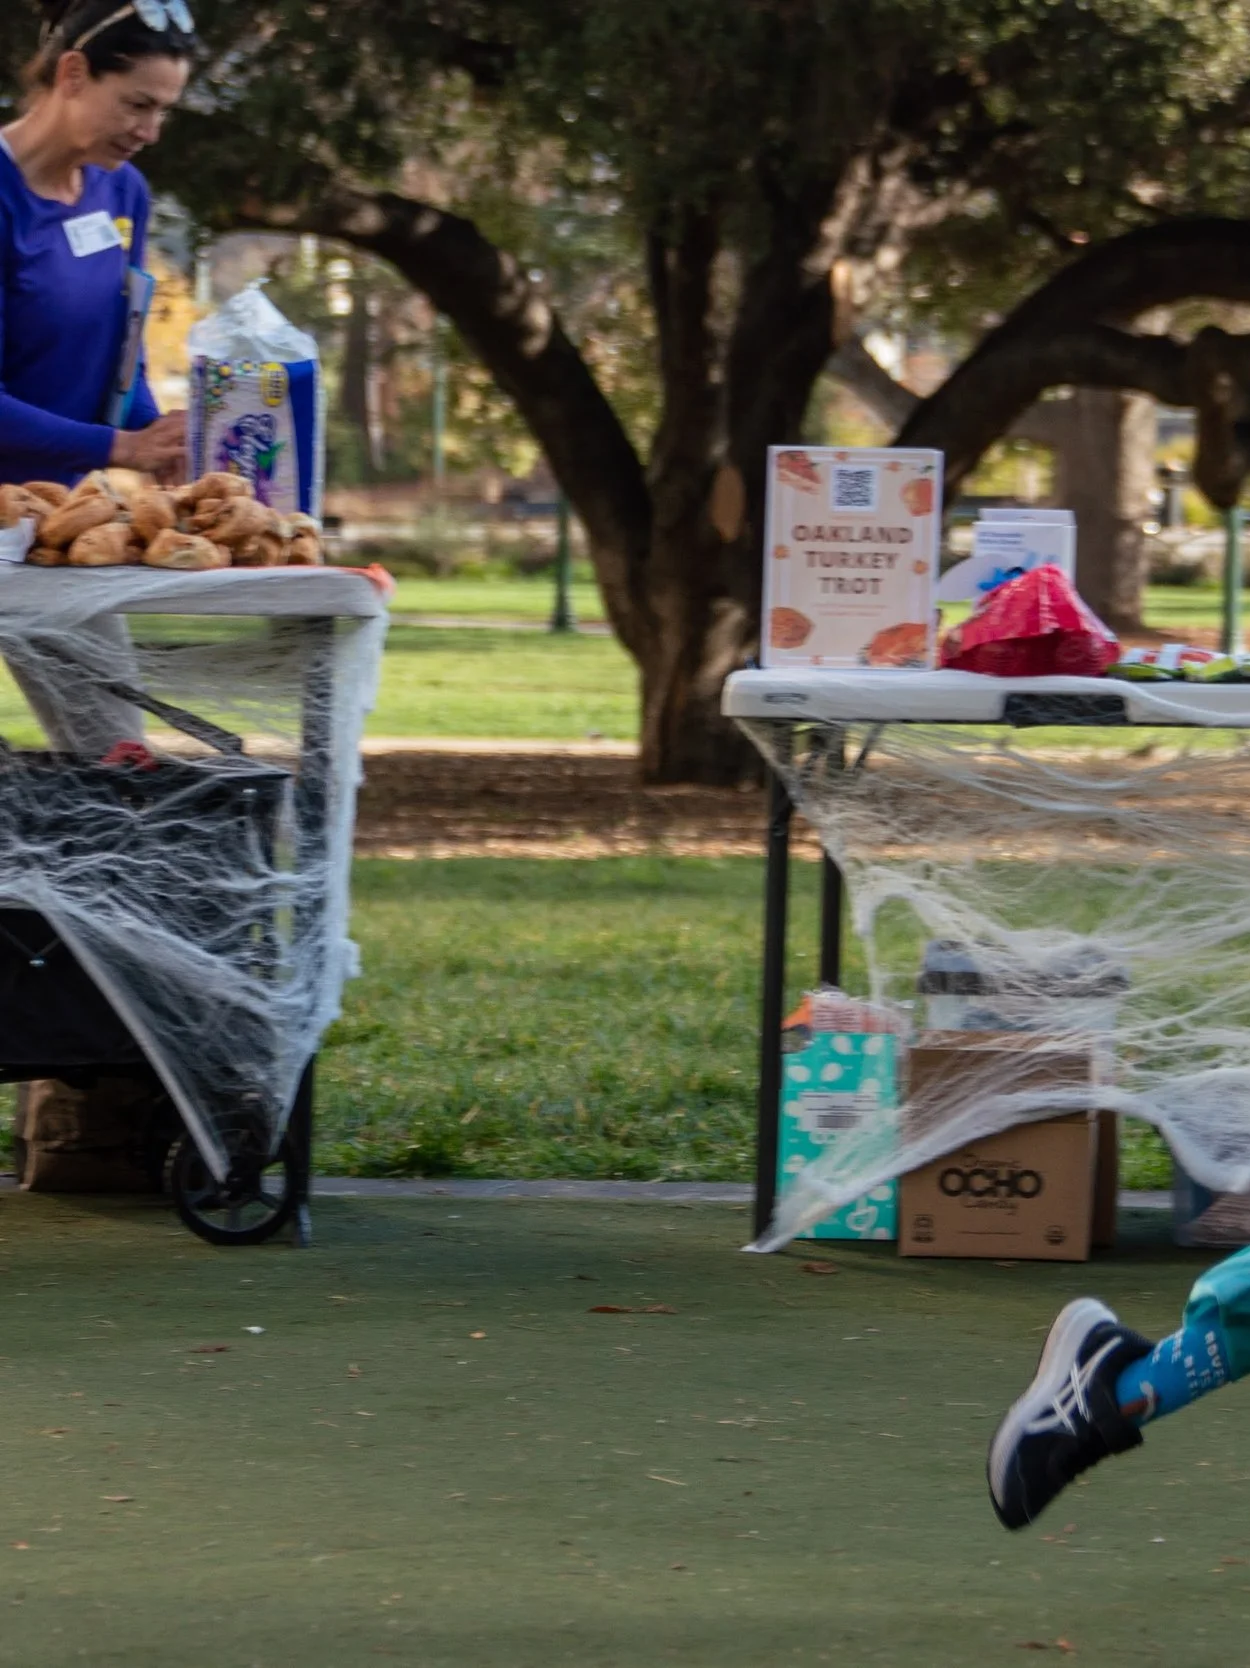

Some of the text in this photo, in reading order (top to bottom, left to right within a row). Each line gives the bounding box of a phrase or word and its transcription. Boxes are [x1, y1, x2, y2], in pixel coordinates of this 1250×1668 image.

[791, 524, 914, 544] OAKLAND
[804, 551, 900, 569] TURKEY
[818, 577, 884, 595] TROT
[939, 1168, 1043, 1198] OCHO
